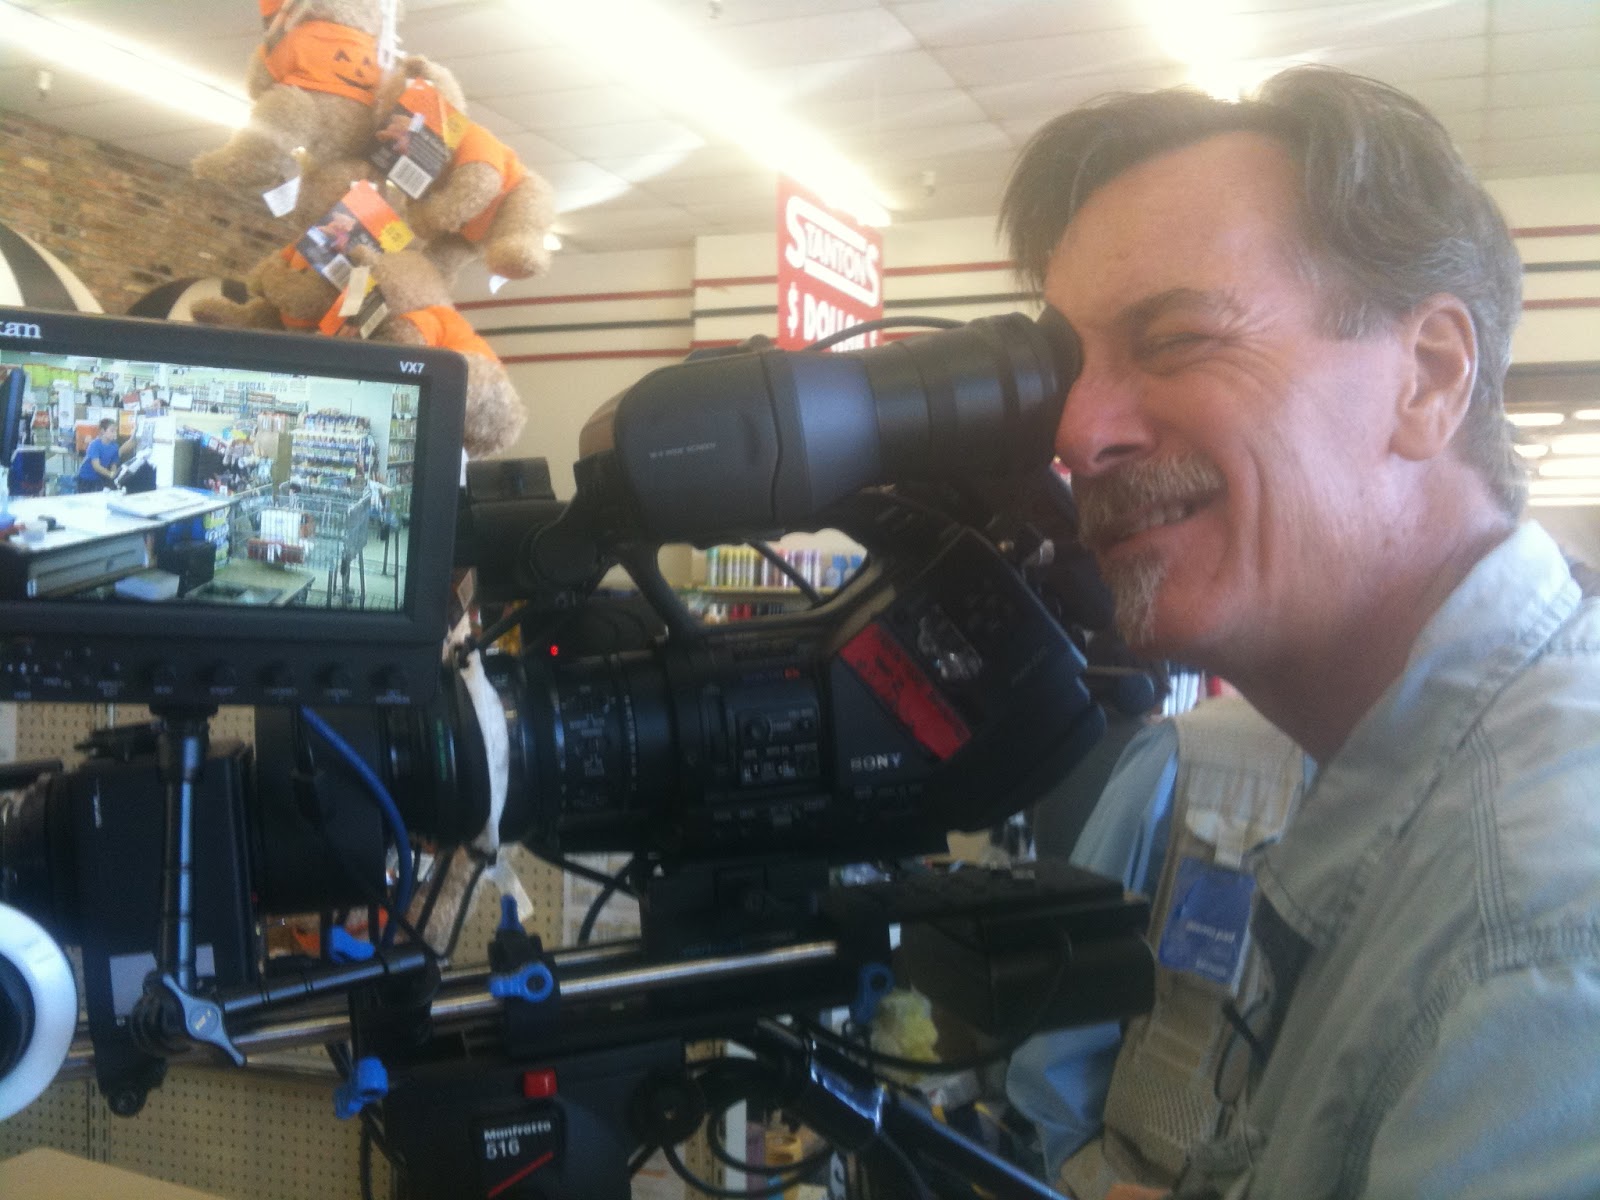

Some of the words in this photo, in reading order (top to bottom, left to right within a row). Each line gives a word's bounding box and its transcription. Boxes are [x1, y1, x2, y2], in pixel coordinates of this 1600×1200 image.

[400, 361, 425, 375] VX7
[850, 752, 902, 773] SONY
[484, 1120, 551, 1140] Manfrotto
